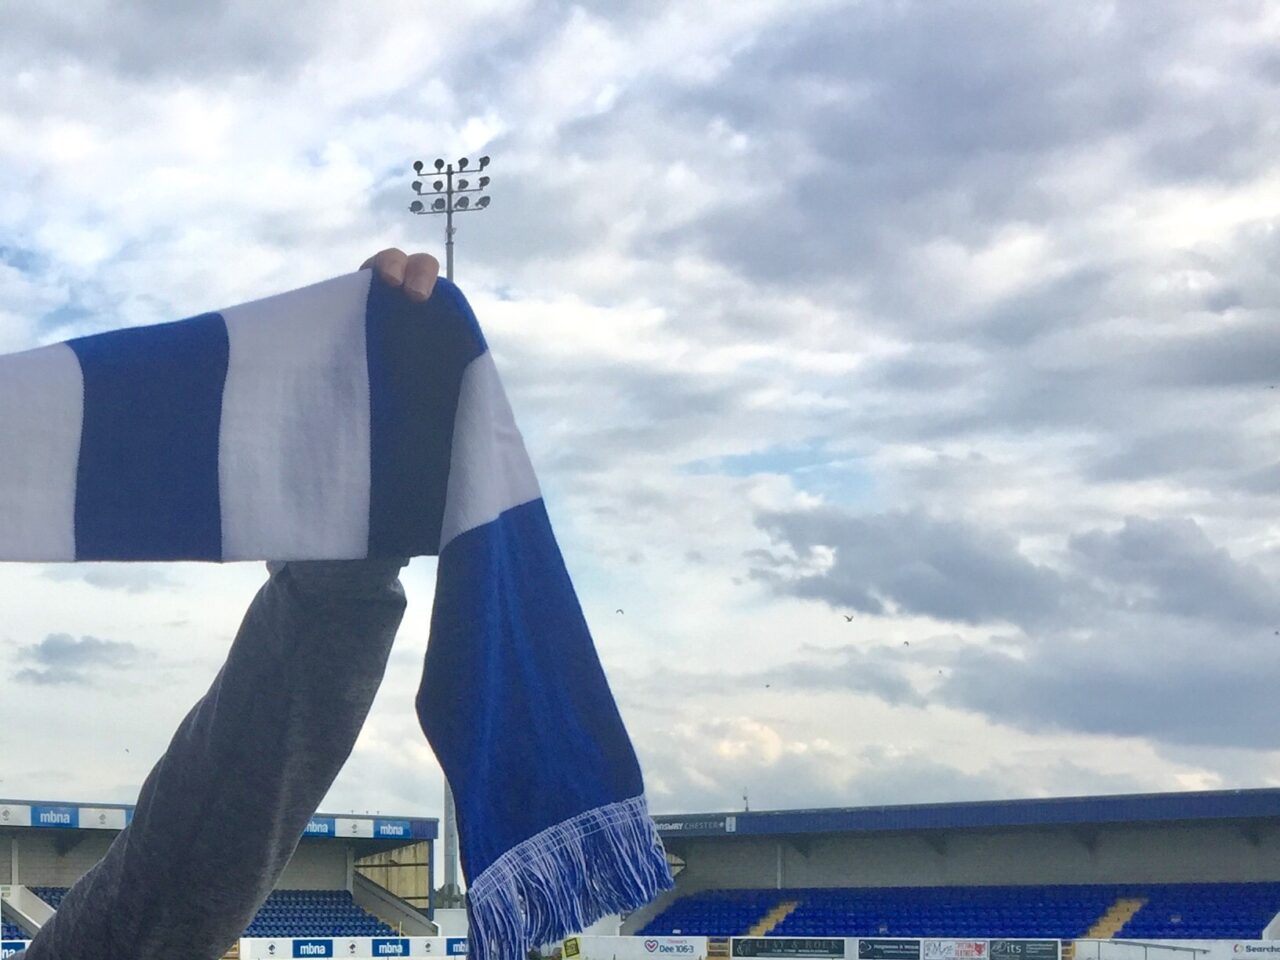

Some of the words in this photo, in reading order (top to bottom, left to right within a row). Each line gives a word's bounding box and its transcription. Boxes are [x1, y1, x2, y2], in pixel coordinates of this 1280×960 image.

[40, 808, 71, 824] mbna
[380, 824, 403, 835] mbna
[300, 942, 326, 955] mbna
[379, 941, 403, 954] mbna
[659, 944, 674, 953] Dee
